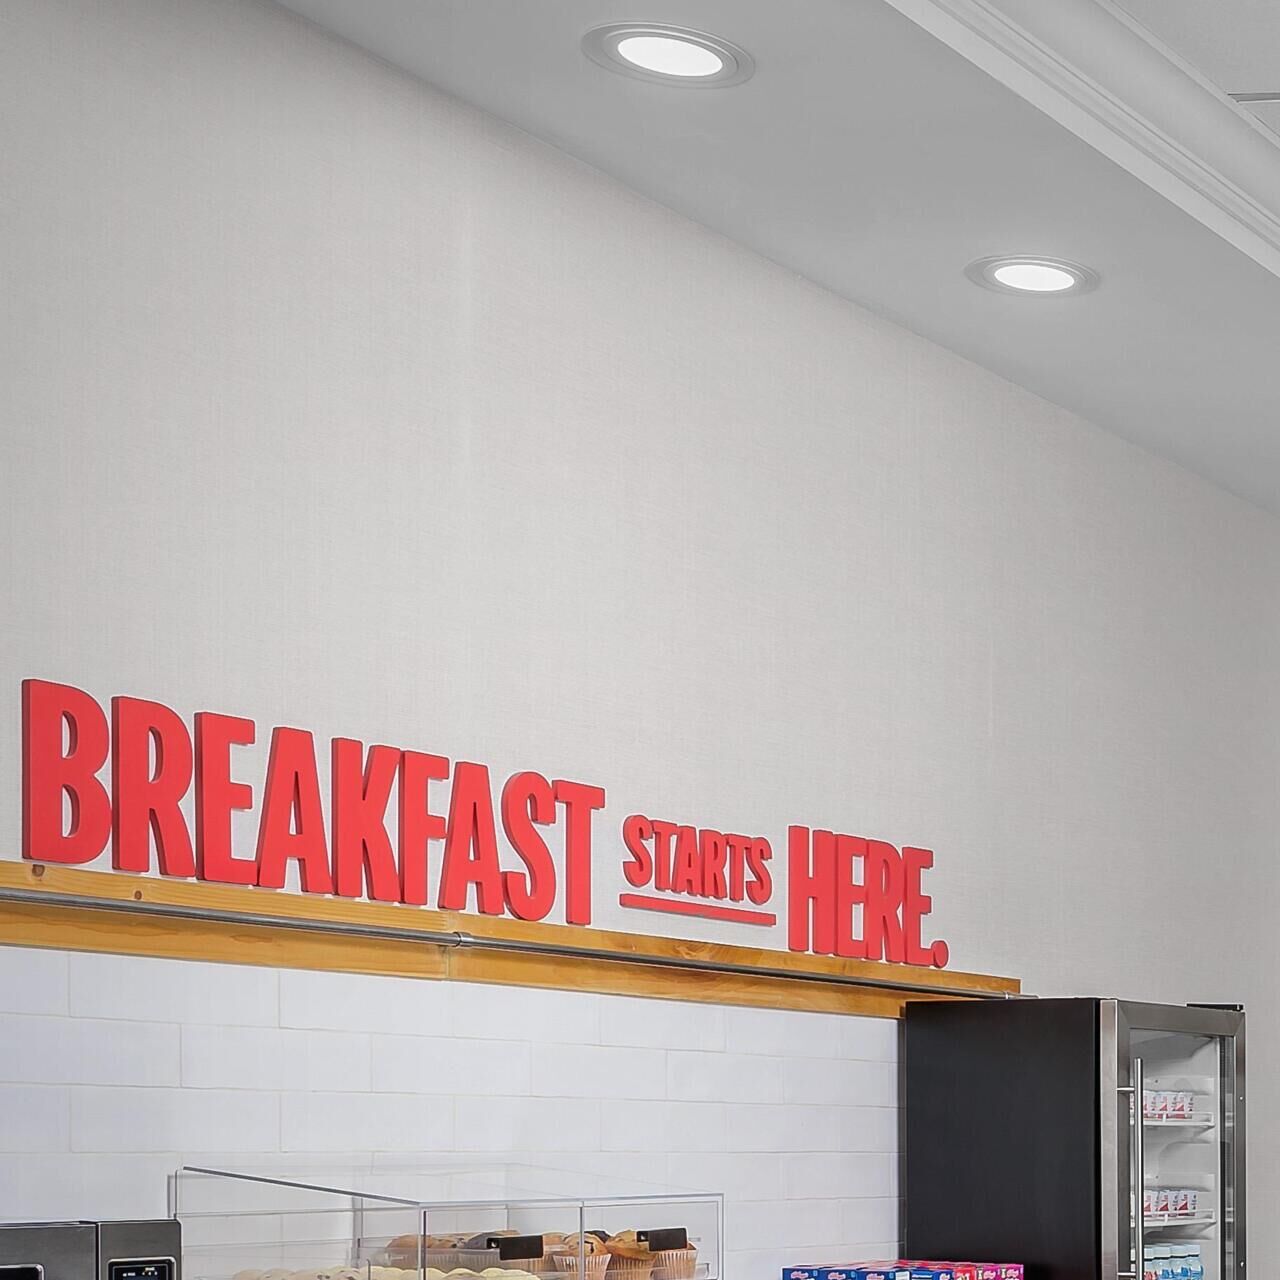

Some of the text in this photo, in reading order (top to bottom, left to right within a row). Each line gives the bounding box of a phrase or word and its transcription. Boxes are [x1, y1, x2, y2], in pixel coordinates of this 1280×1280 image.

[21, 677, 950, 968] BREAKFAST STARTS HERE.
